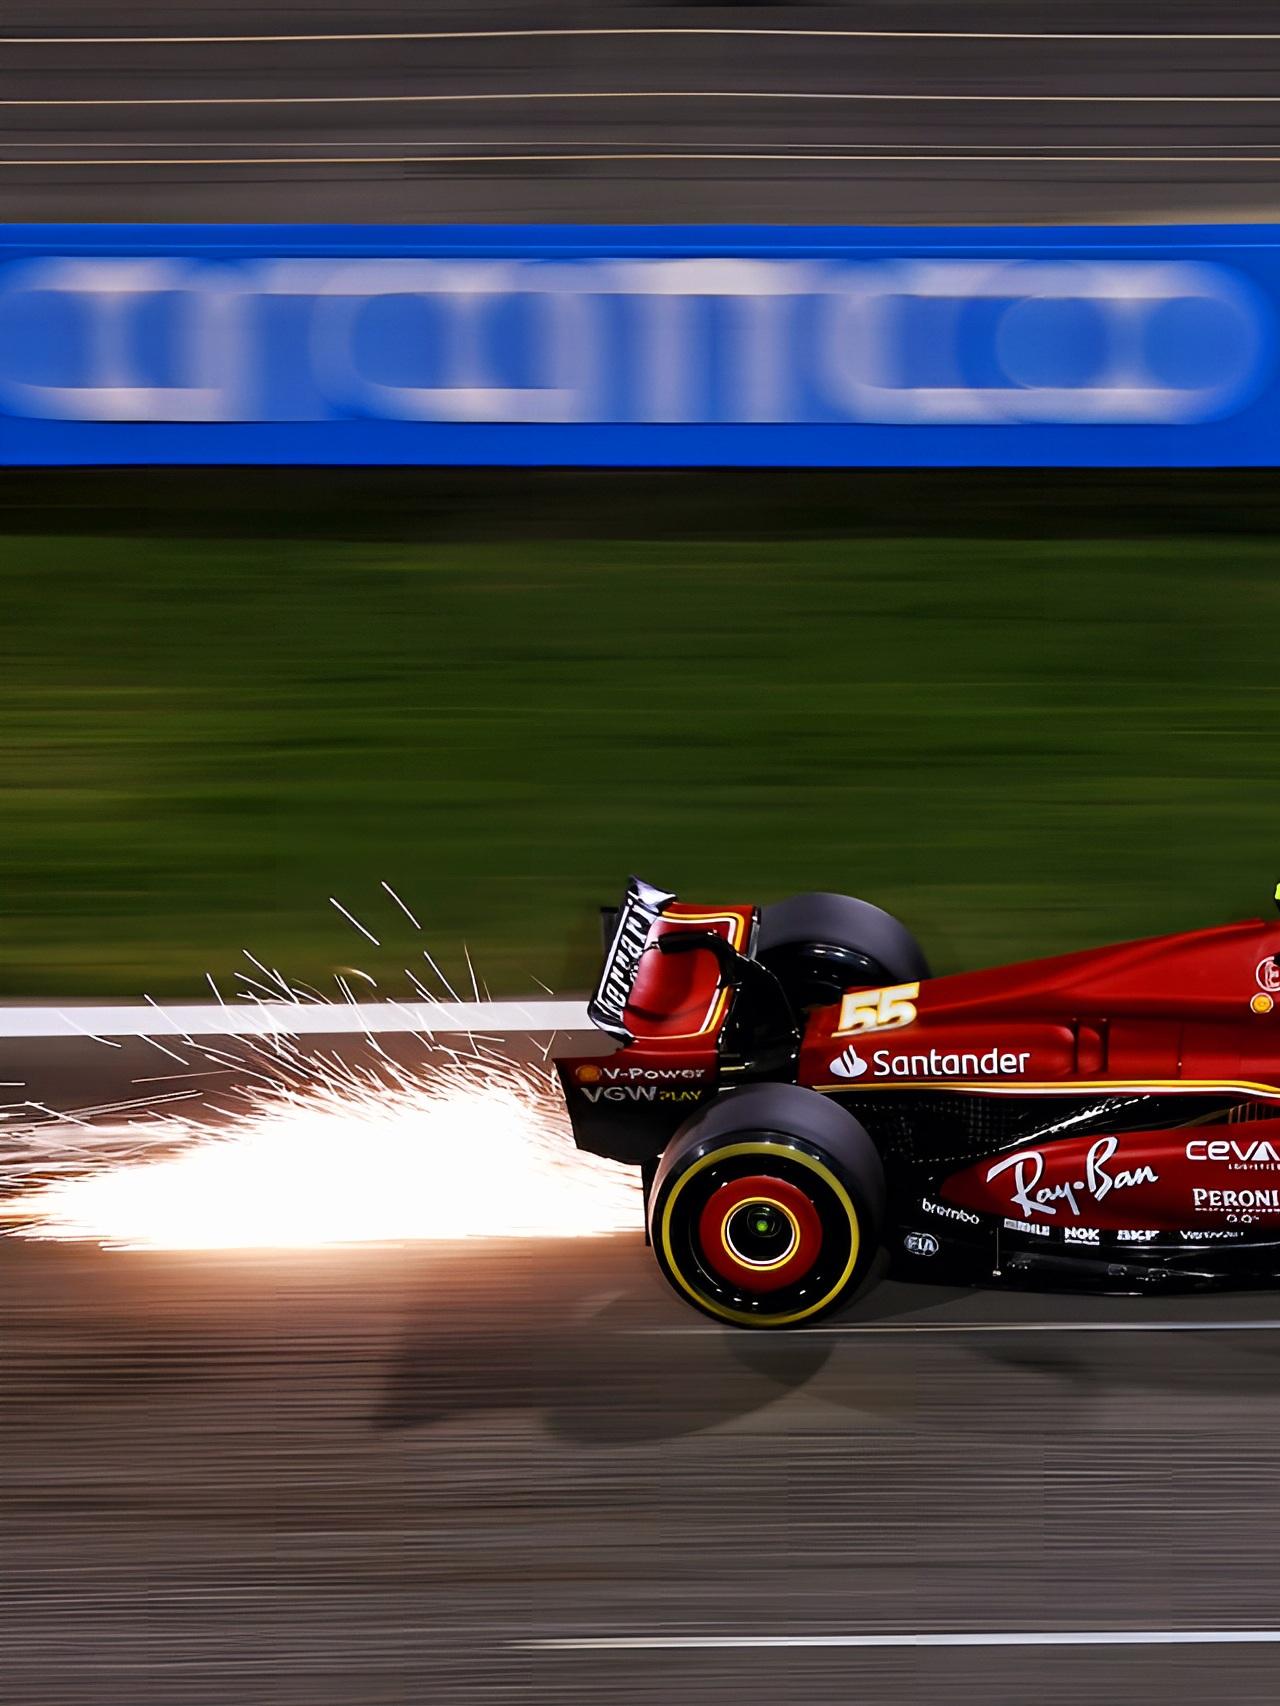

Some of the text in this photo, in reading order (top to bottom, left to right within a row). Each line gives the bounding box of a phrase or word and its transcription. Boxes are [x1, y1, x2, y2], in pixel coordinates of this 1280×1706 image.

[831, 982, 920, 1038] 55
[603, 1067, 705, 1080] V-Power
[873, 1048, 1031, 1077] Santander
[581, 1086, 657, 1103] VGW
[986, 1136, 1159, 1218] Ray-Ban
[1192, 1188, 1280, 1207] PERONI
